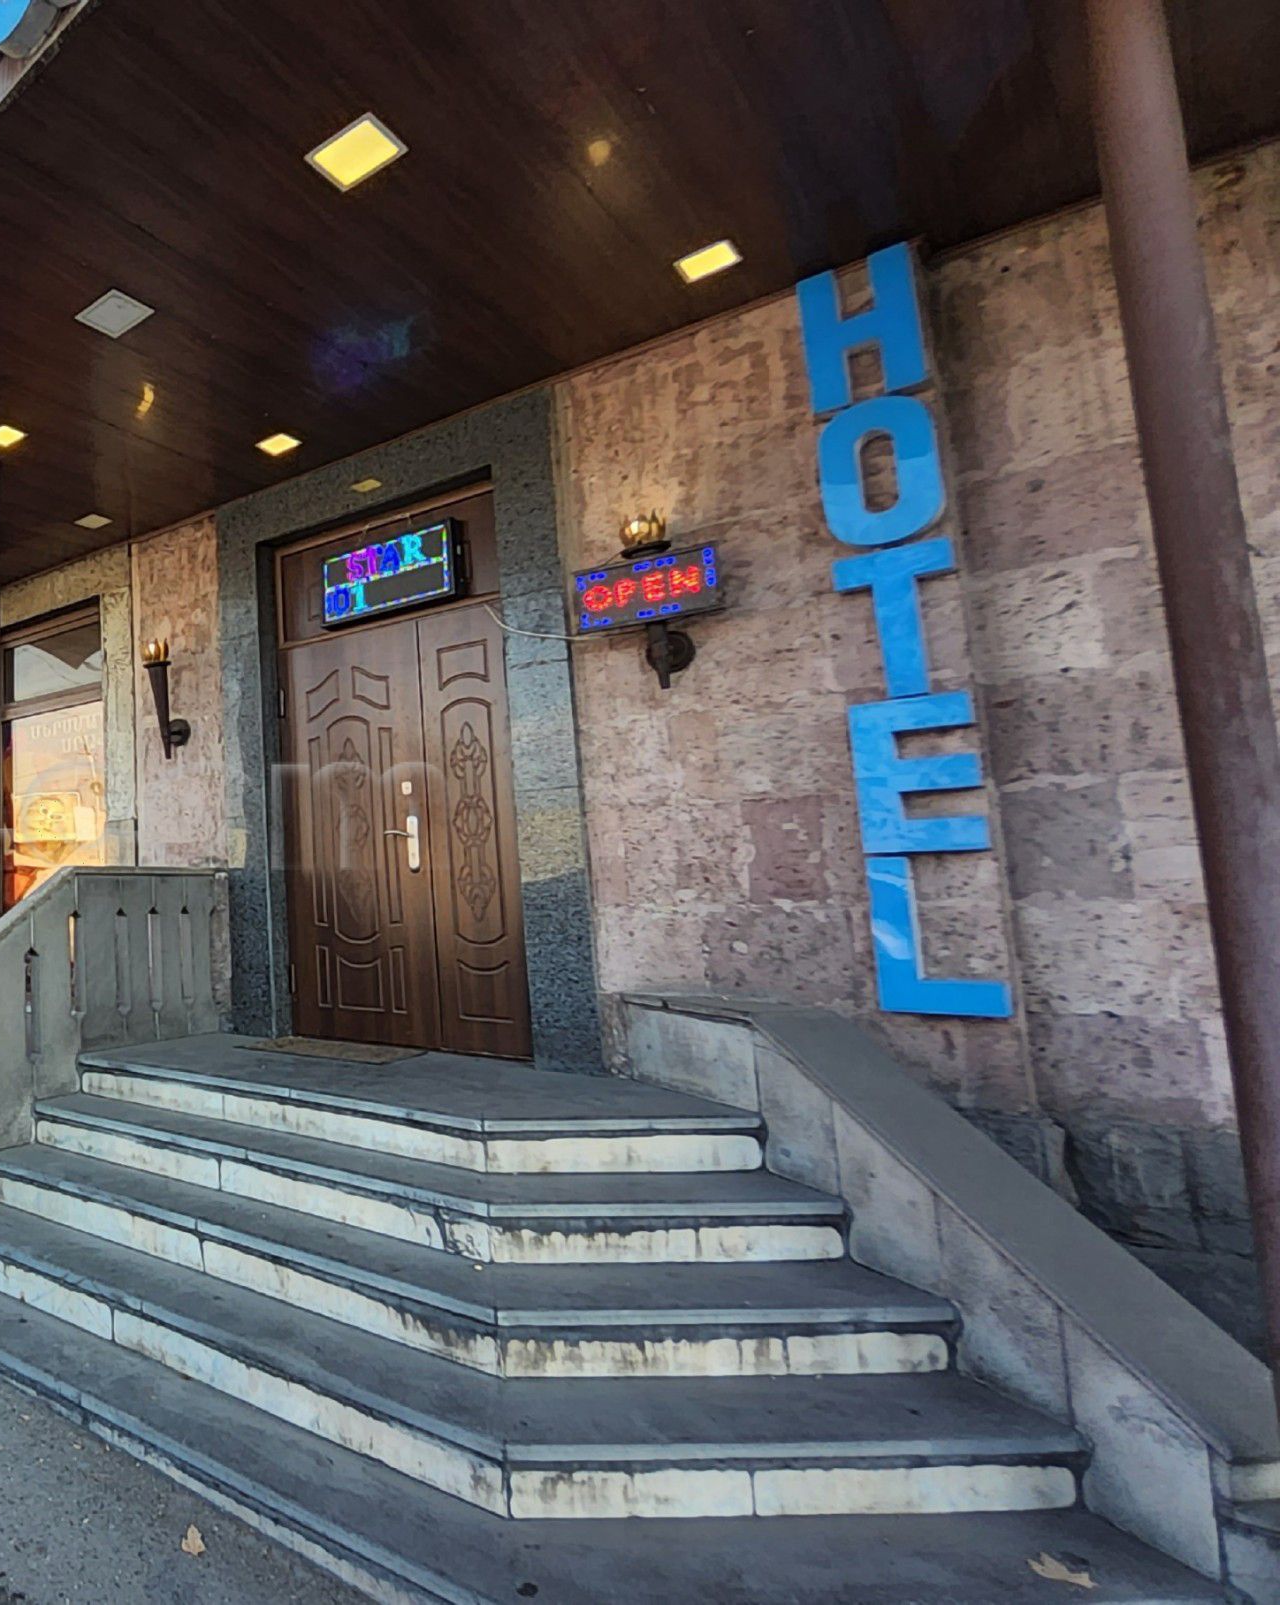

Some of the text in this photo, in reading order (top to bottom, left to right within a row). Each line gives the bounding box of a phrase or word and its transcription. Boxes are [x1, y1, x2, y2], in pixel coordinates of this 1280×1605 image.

[346, 534, 426, 583] STAR
[583, 565, 701, 612] OPEN
[796, 242, 1014, 1018] HOTEL
